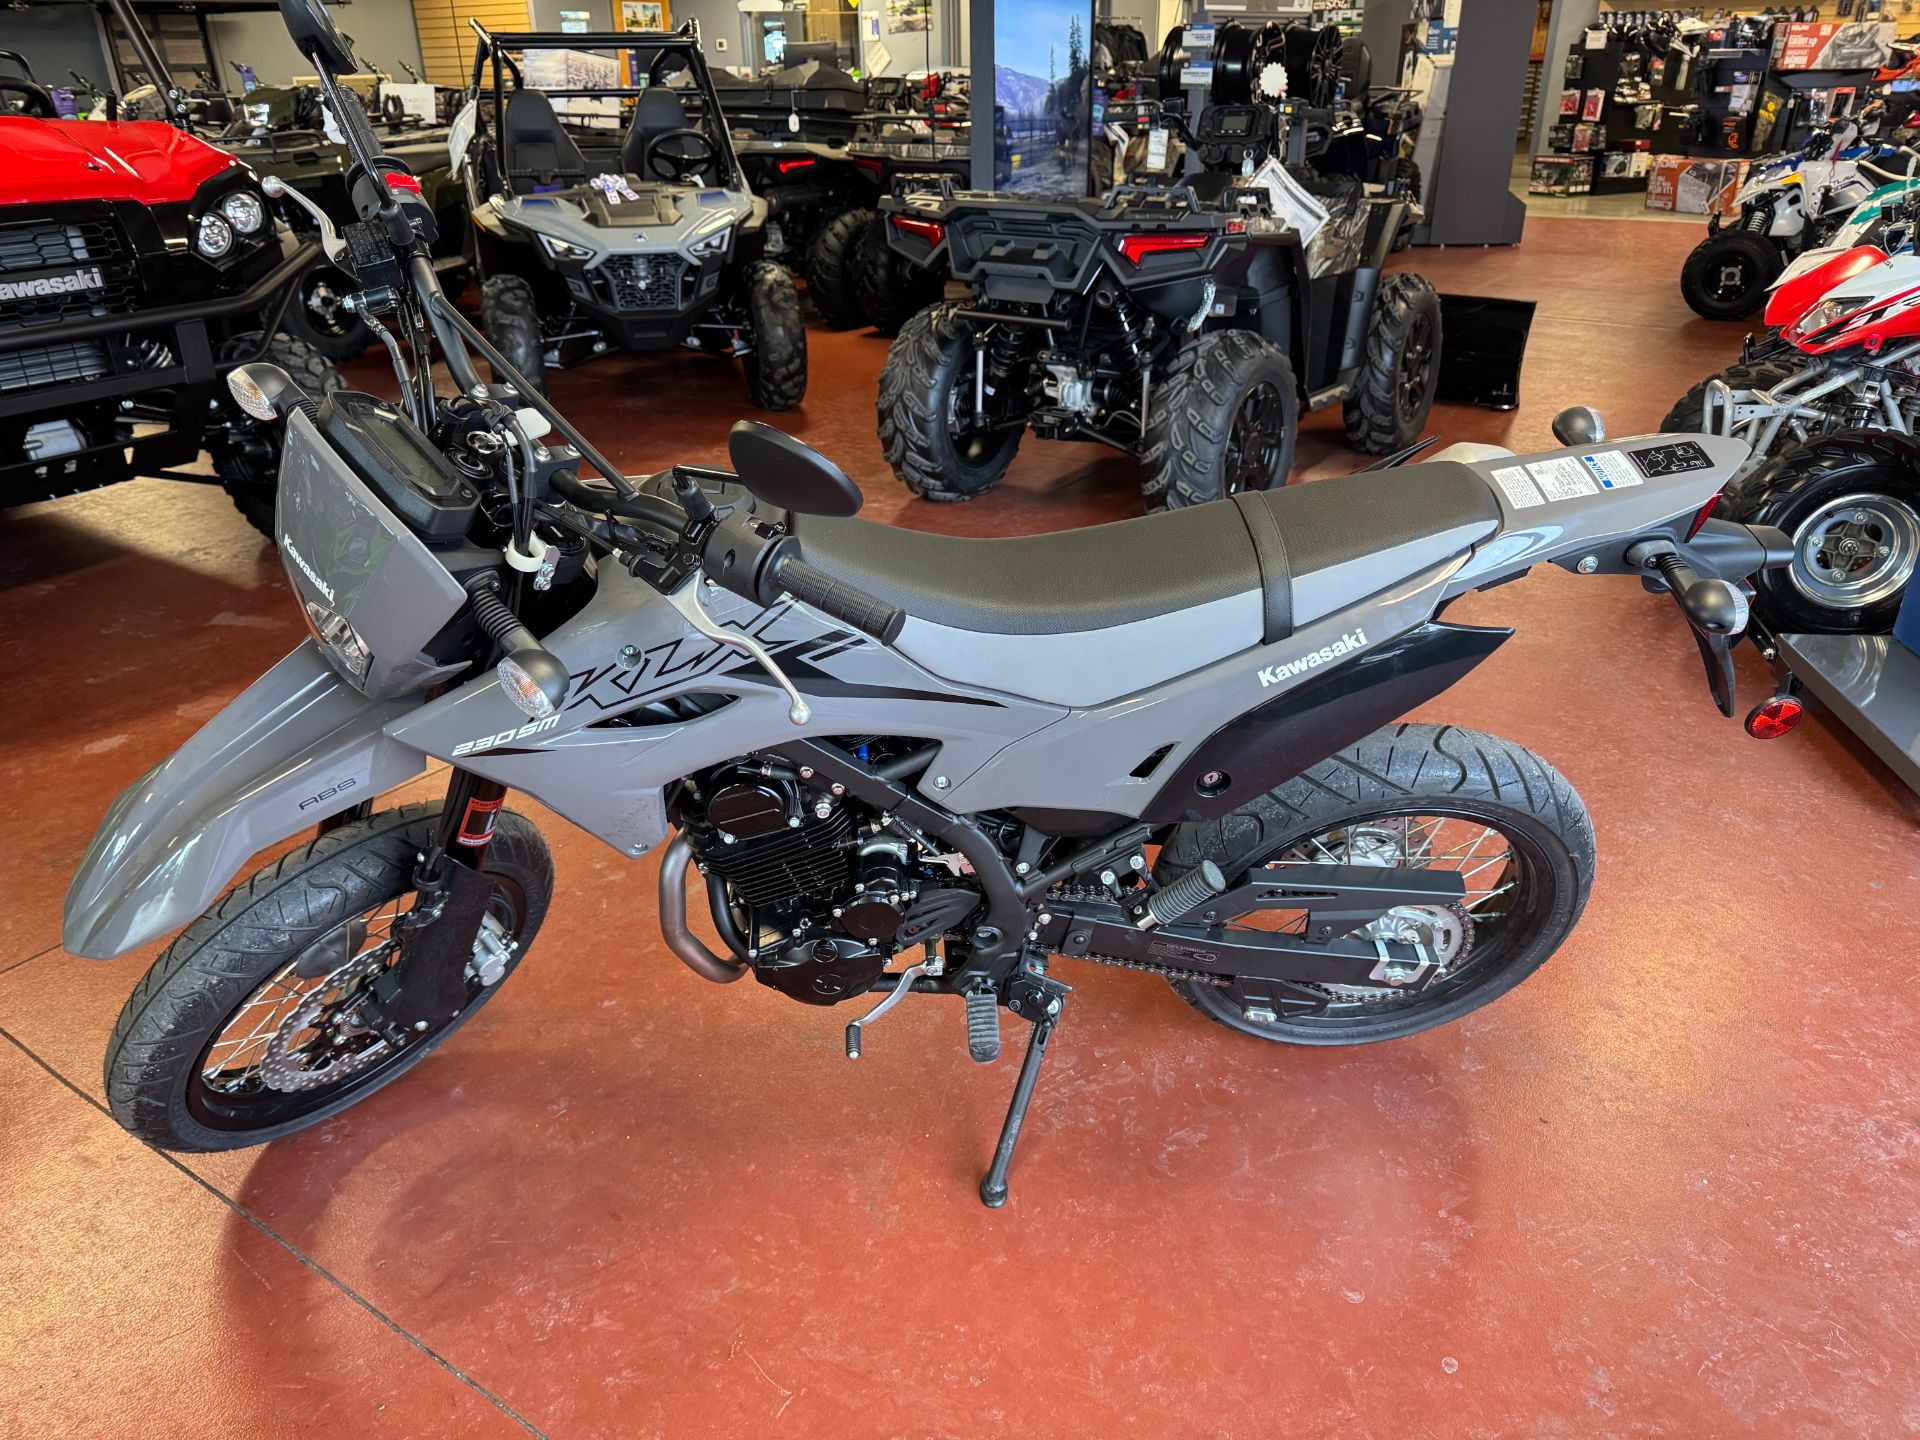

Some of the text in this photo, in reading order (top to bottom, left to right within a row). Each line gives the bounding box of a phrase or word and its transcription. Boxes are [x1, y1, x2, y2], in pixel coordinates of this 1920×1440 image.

[0, 267, 104, 300] awasaki
[283, 533, 335, 602] Kawasaki
[1257, 627, 1368, 688] Kawasaki
[298, 777, 357, 811] ABS
